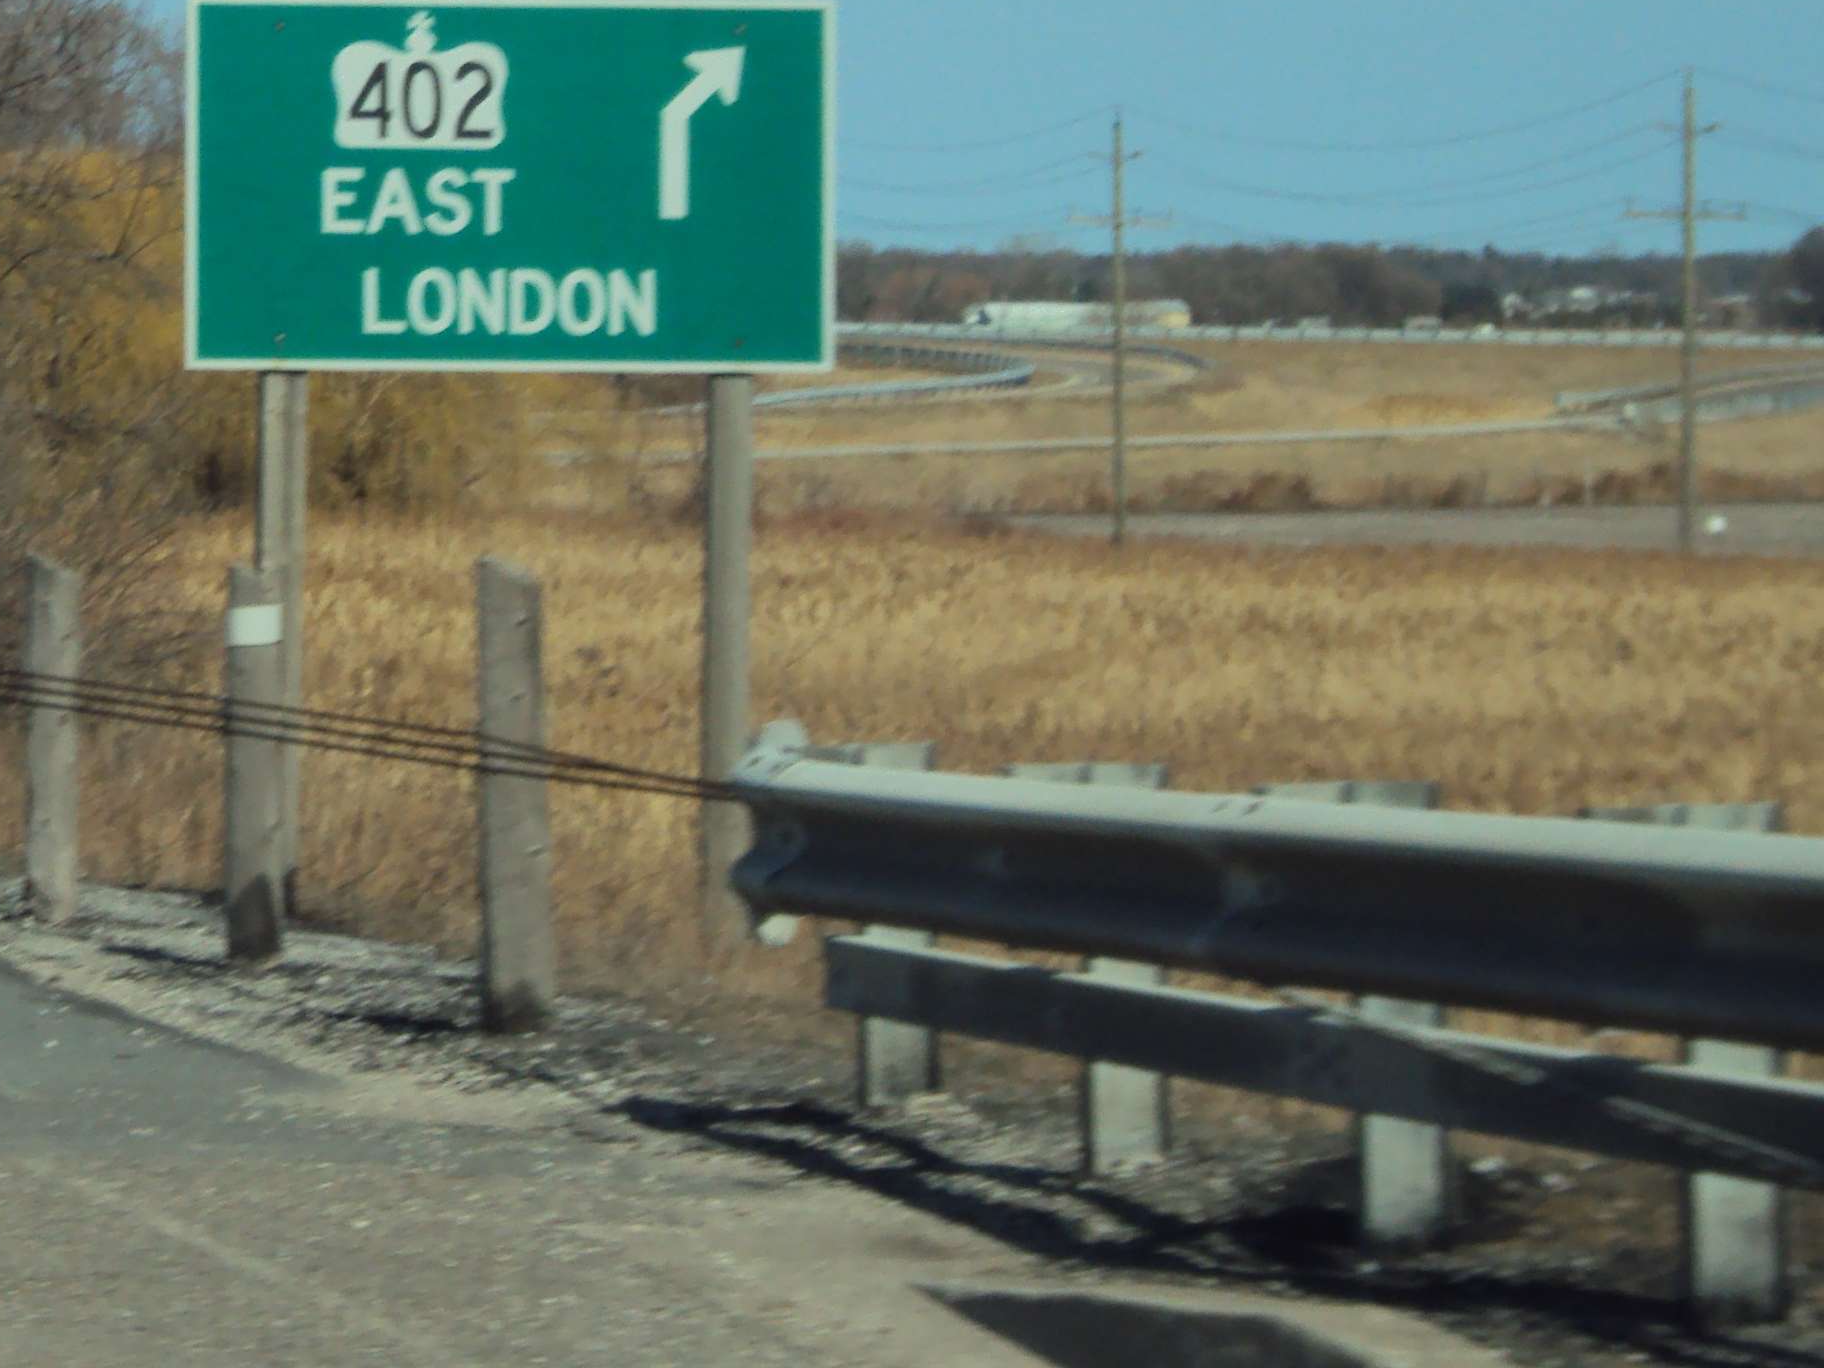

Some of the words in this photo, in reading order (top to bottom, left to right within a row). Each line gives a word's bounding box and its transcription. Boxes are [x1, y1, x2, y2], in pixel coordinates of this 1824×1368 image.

[348, 60, 495, 140] 402
[320, 166, 516, 235] EAST
[361, 266, 658, 336] LONDON
